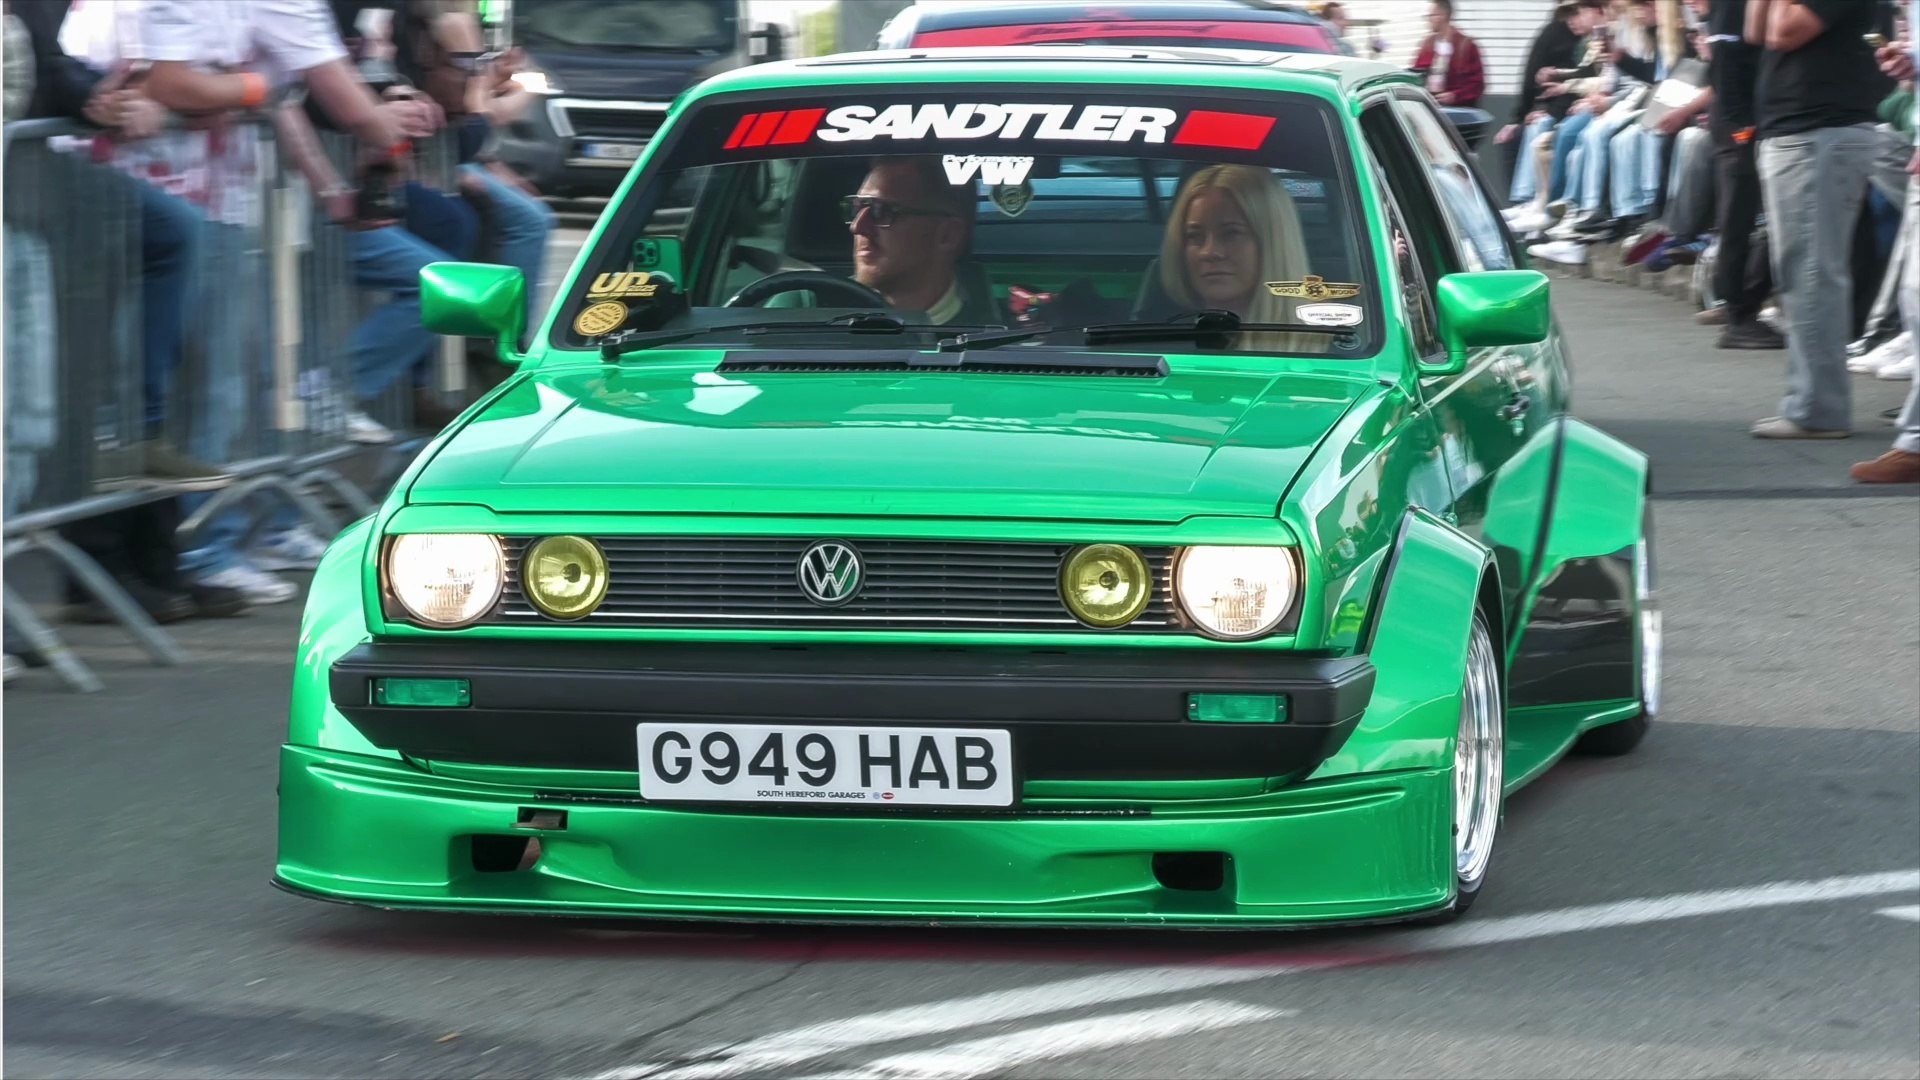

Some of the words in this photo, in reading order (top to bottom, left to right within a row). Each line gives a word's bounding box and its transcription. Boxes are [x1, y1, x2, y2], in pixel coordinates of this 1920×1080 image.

[816, 103, 1177, 143] SANDTLER
[942, 160, 1034, 185] VW
[800, 543, 860, 601] VW
[652, 730, 837, 787] G949
[858, 733, 998, 791] HAB
[756, 790, 784, 798] SOUTH
[785, 790, 826, 799] HEREFORD
[828, 791, 866, 799] GARAGES
